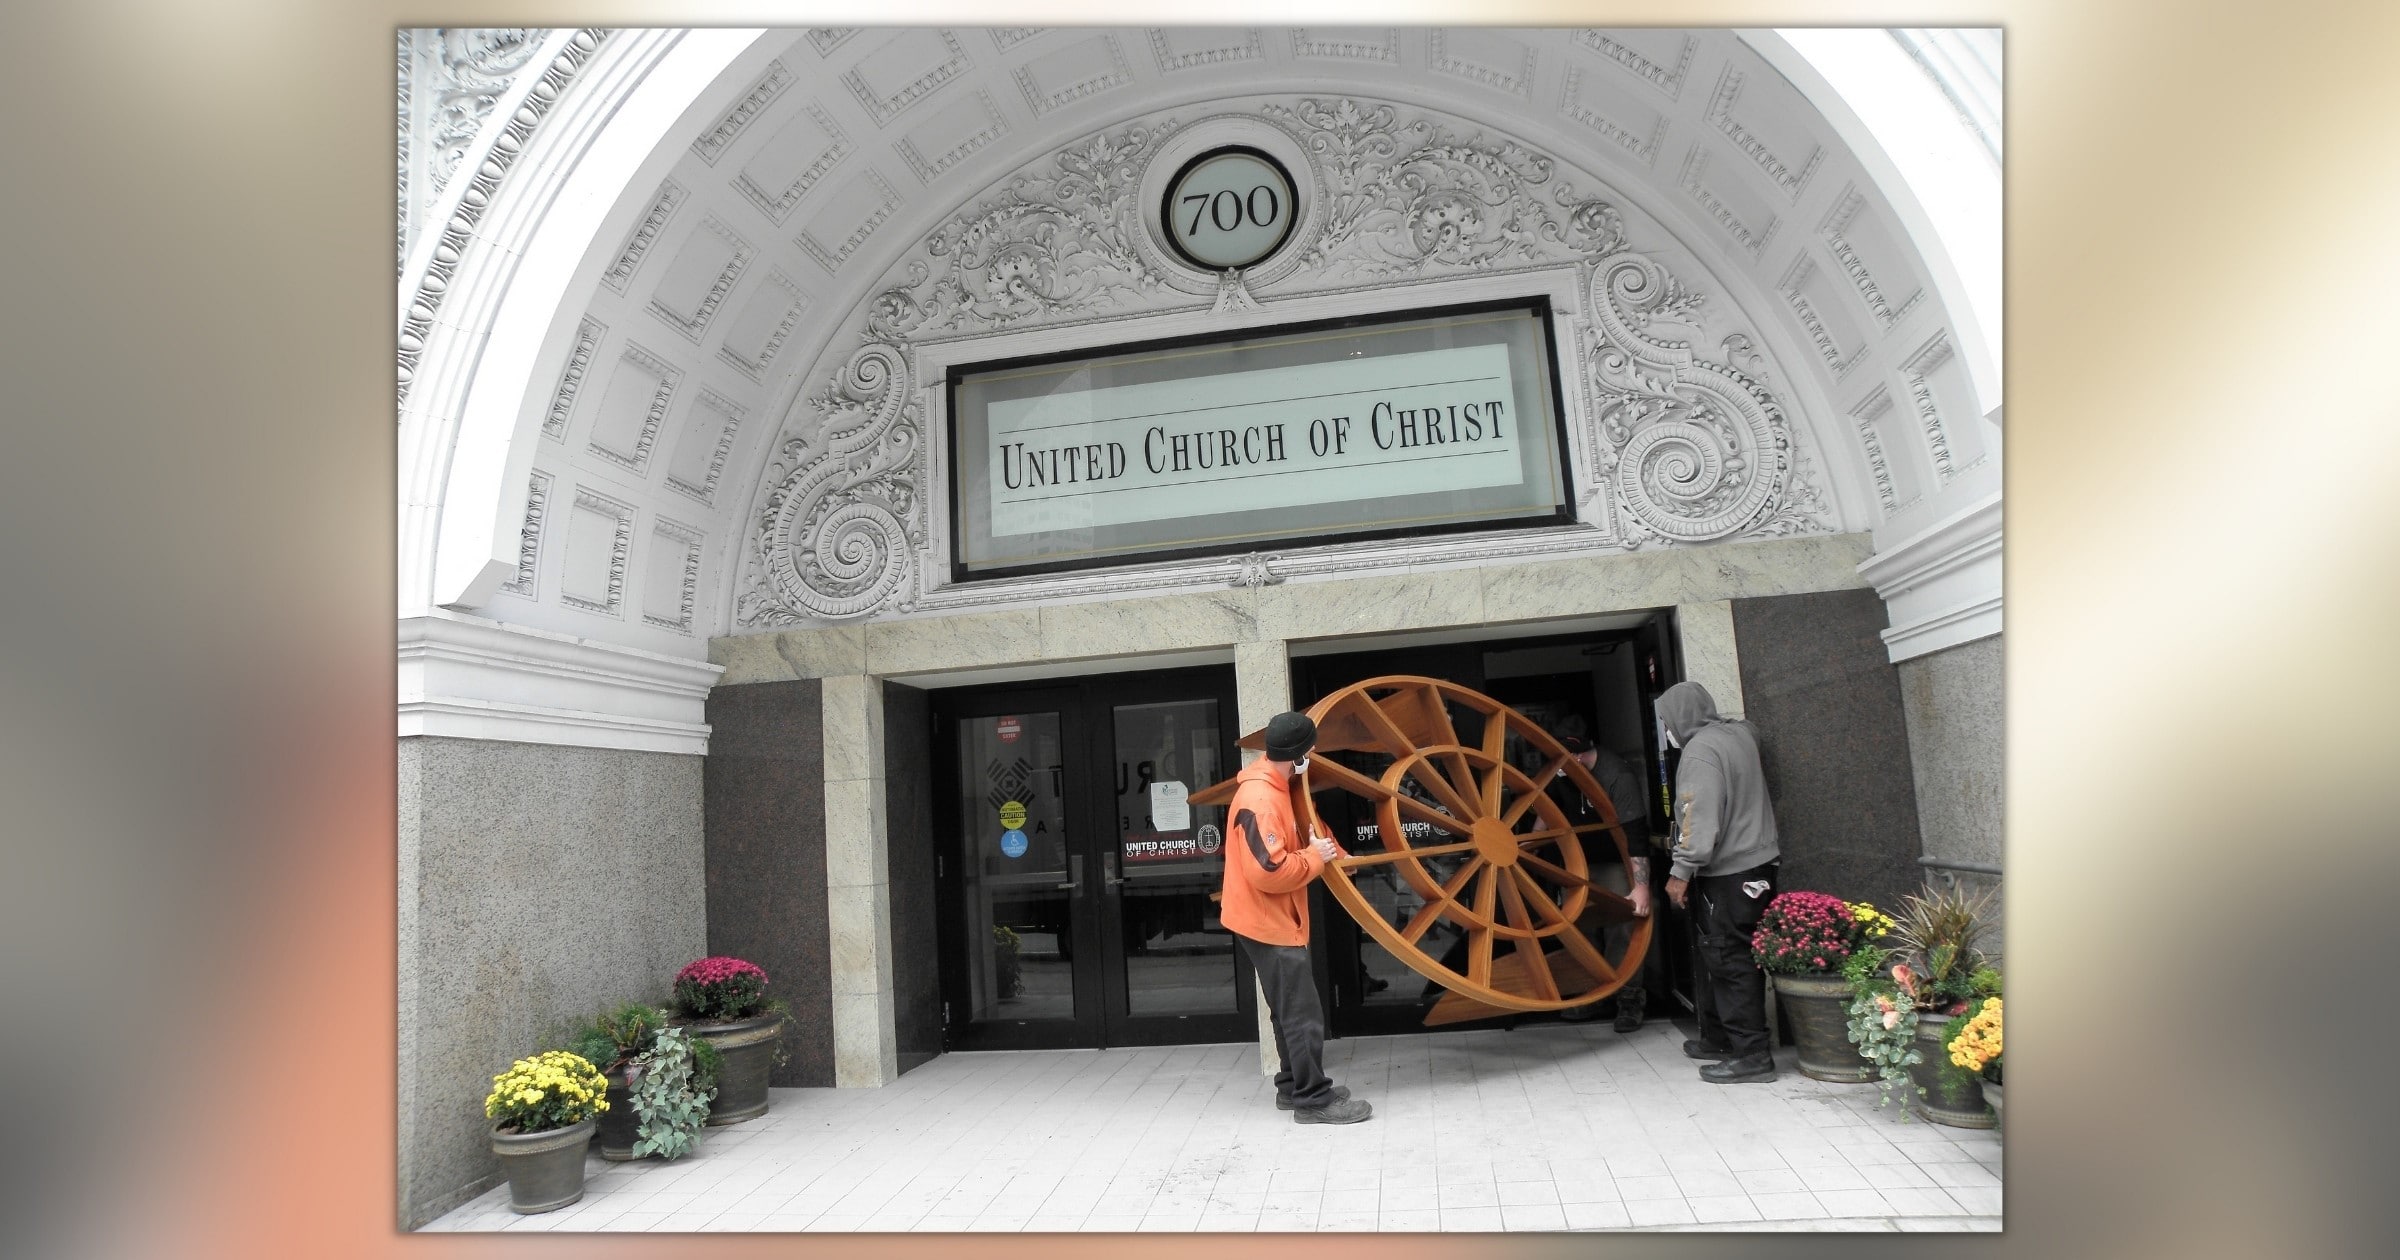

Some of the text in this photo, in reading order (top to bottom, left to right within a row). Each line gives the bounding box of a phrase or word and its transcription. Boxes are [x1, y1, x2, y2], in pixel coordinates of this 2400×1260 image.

[1183, 185, 1279, 236] 700
[1000, 442, 1126, 490] UNITED
[1144, 423, 1288, 474] CHURCH
[1371, 401, 1504, 450] CHRIST
[1357, 822, 1430, 835] UNIT HURCH
[1357, 833, 1374, 841] OF
[1126, 839, 1196, 852] UNITED CHURCH
[1126, 847, 1197, 858] OF CHRIST
